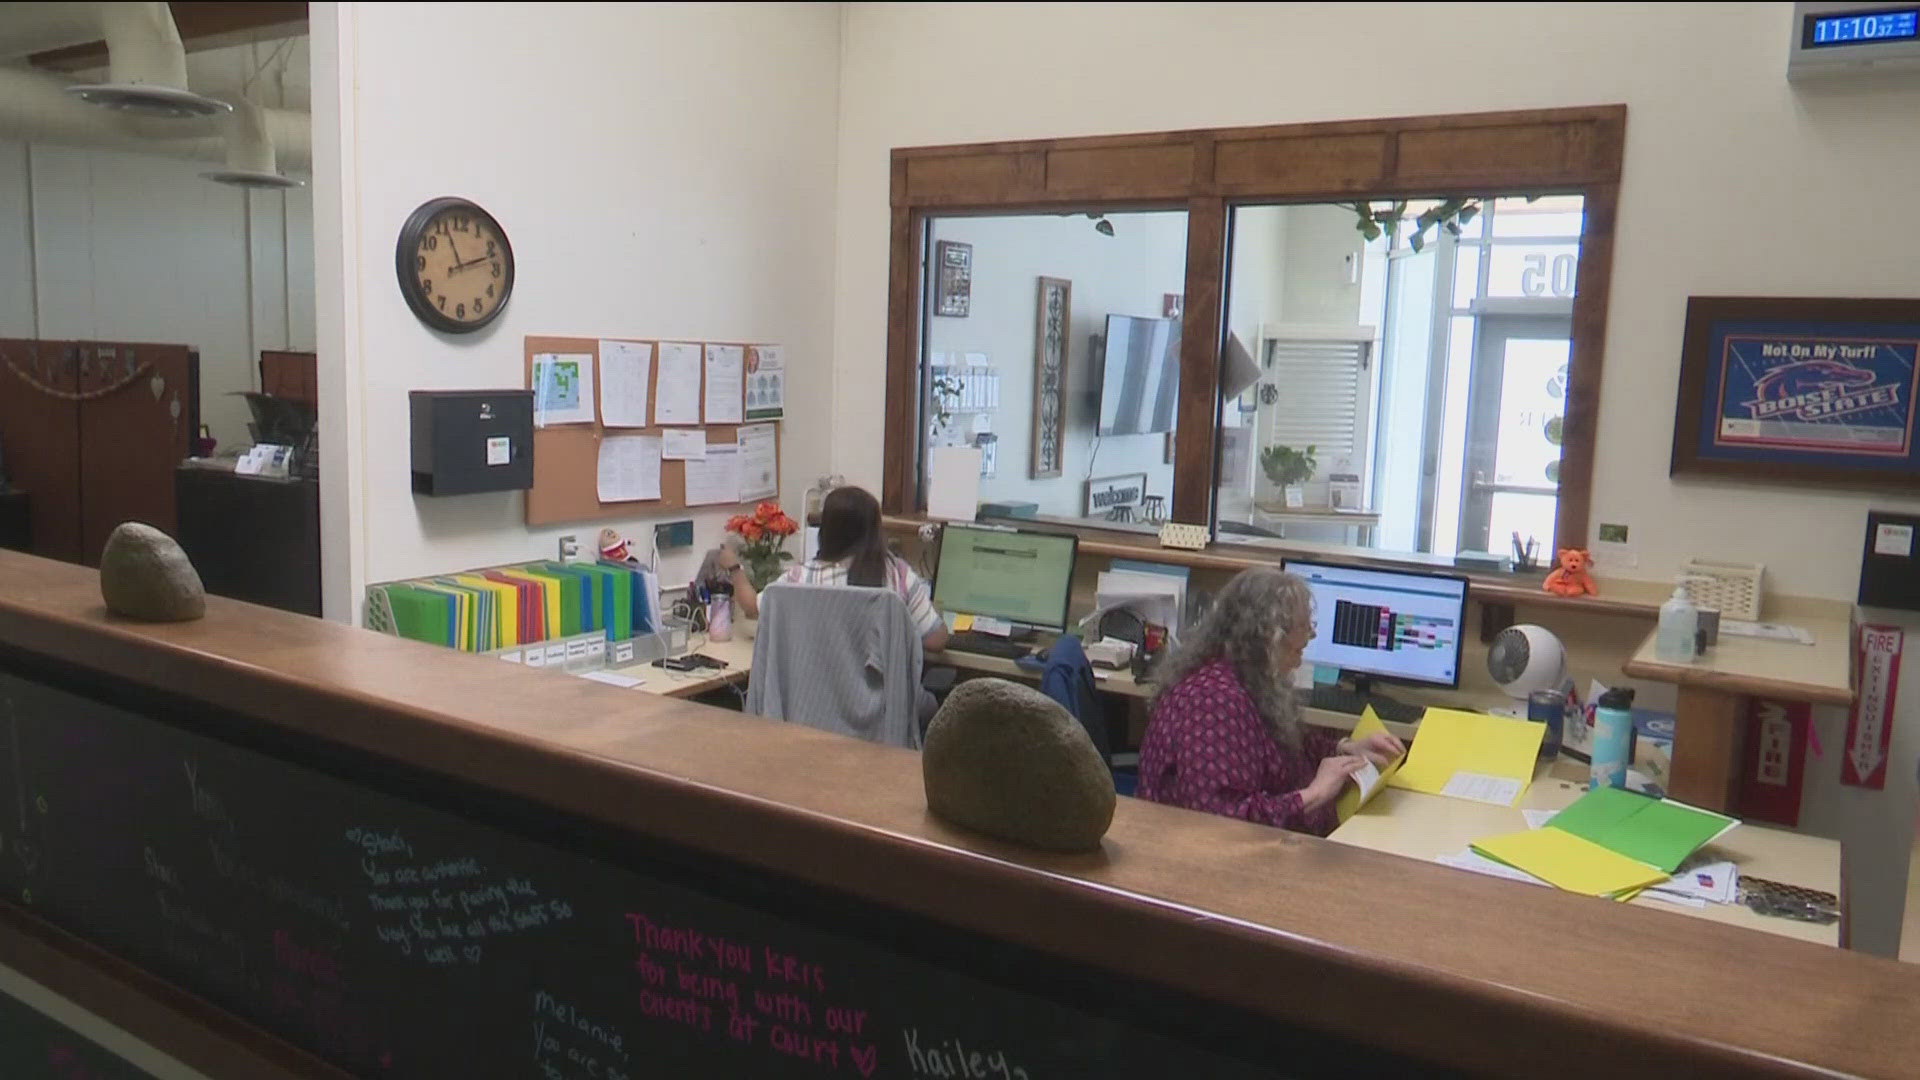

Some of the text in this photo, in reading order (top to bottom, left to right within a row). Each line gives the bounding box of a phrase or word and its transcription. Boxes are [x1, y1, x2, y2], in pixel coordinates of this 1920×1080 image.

[1817, 17, 1877, 42] 11:10
[453, 216, 469, 232] 12
[421, 235, 437, 251] 10
[423, 279, 432, 295] 8
[438, 295, 446, 310] 7
[473, 298, 483, 314] 5
[456, 303, 465, 320] 6
[1763, 344, 1876, 360] Not On My Turf!
[1758, 384, 1840, 415] BOISE
[1804, 389, 1890, 417] STATE
[1867, 634, 1894, 653] FIRE
[367, 894, 407, 911] Thank
[625, 912, 703, 960] Thank
[635, 952, 666, 986] for
[825, 1006, 869, 1034] our
